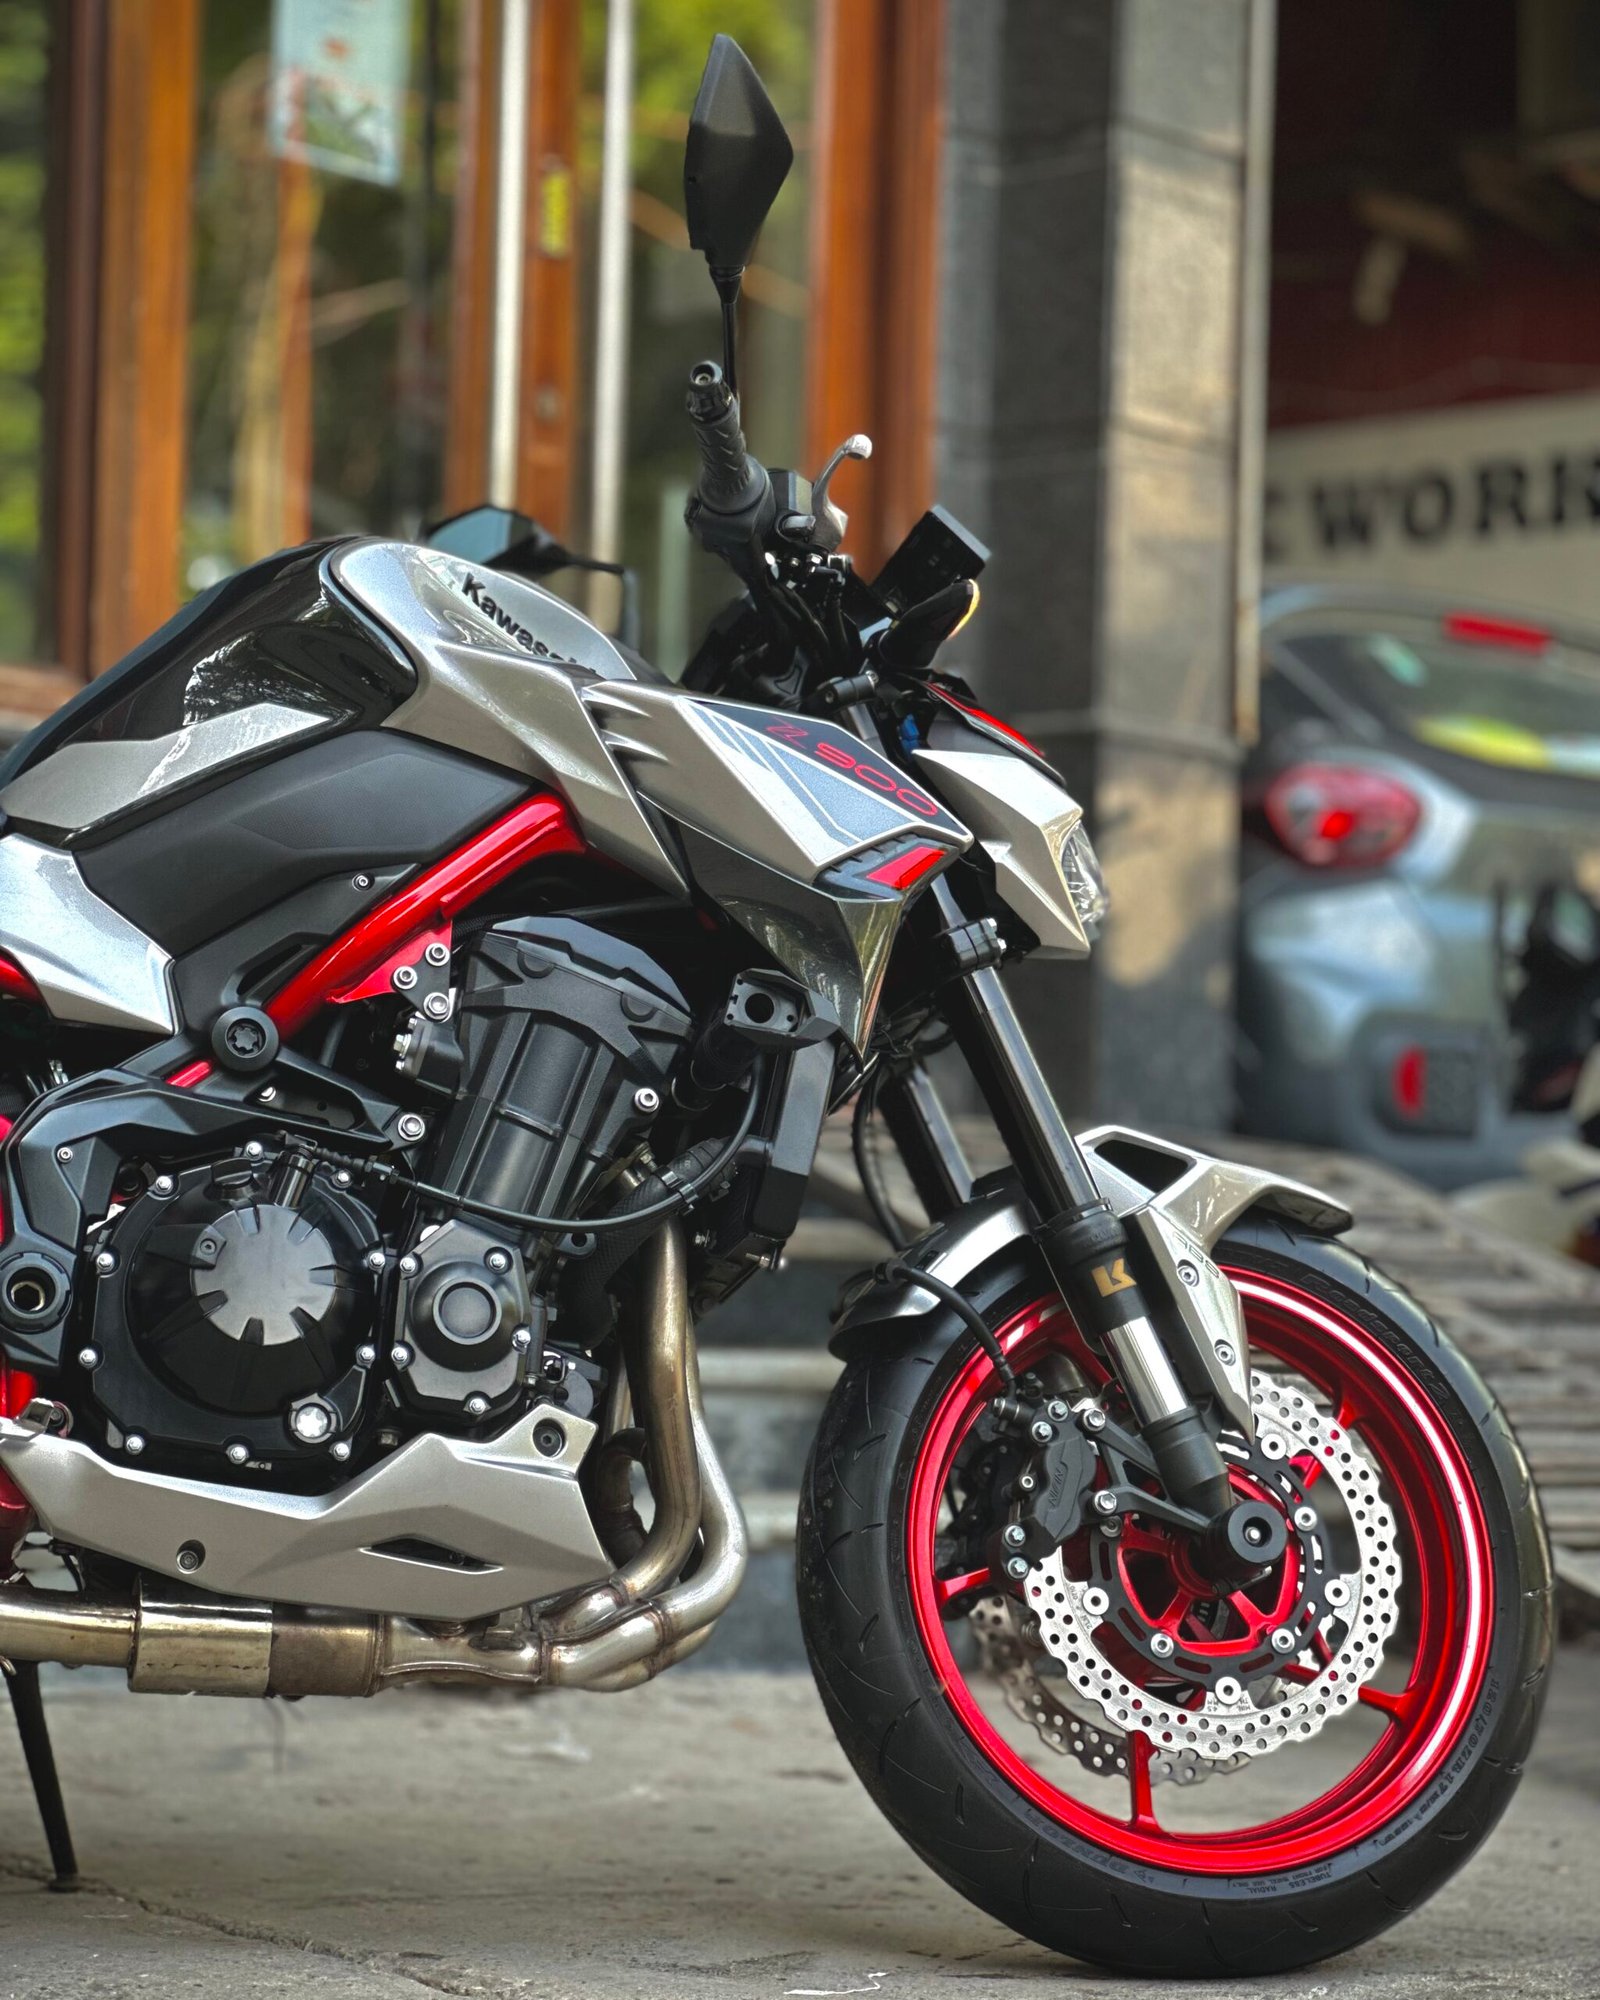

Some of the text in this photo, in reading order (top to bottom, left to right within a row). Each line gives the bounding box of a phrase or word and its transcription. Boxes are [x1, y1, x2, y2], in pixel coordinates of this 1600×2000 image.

[461, 572, 596, 674] Kawas
[1172, 1230, 1219, 1278] ABS
[1247, 1872, 1331, 1894] TUBELESS RADIAL
